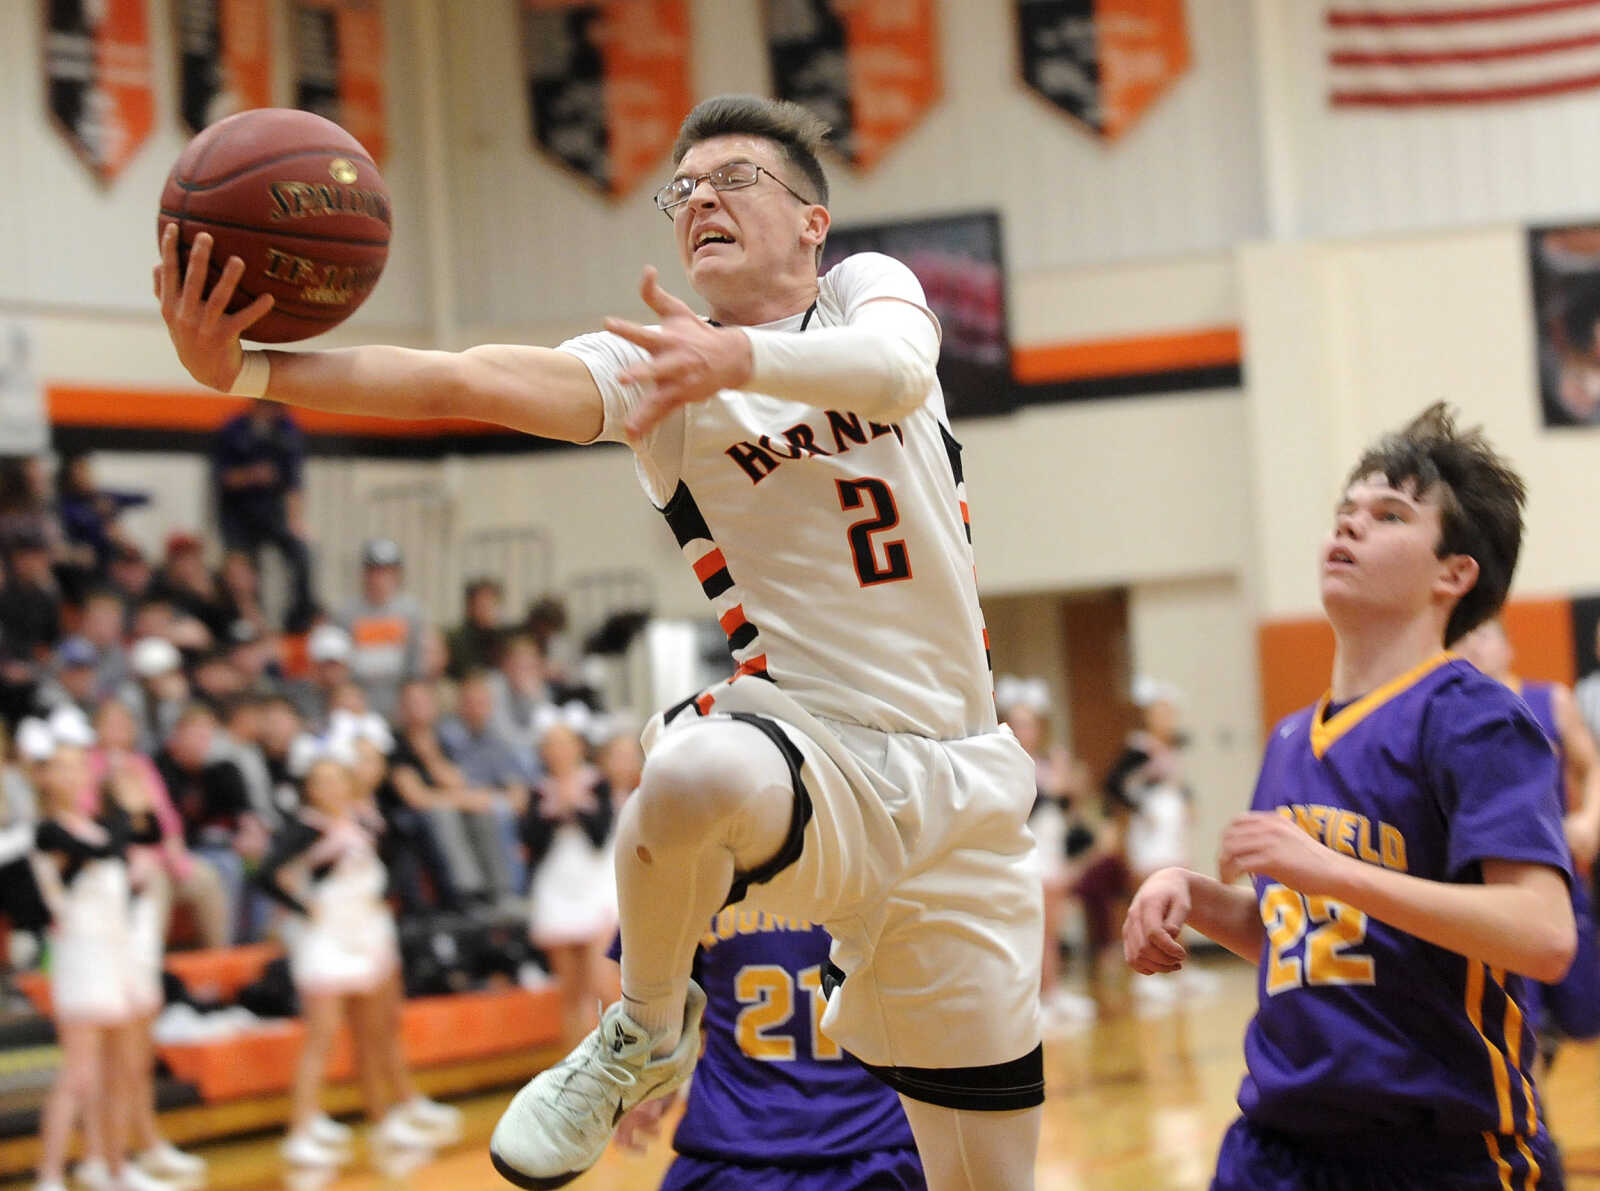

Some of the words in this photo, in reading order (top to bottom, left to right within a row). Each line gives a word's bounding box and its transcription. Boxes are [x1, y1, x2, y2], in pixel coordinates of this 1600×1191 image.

[835, 477, 913, 588] 2
[1260, 882, 1376, 997] 22
[734, 964, 844, 1062] 21
